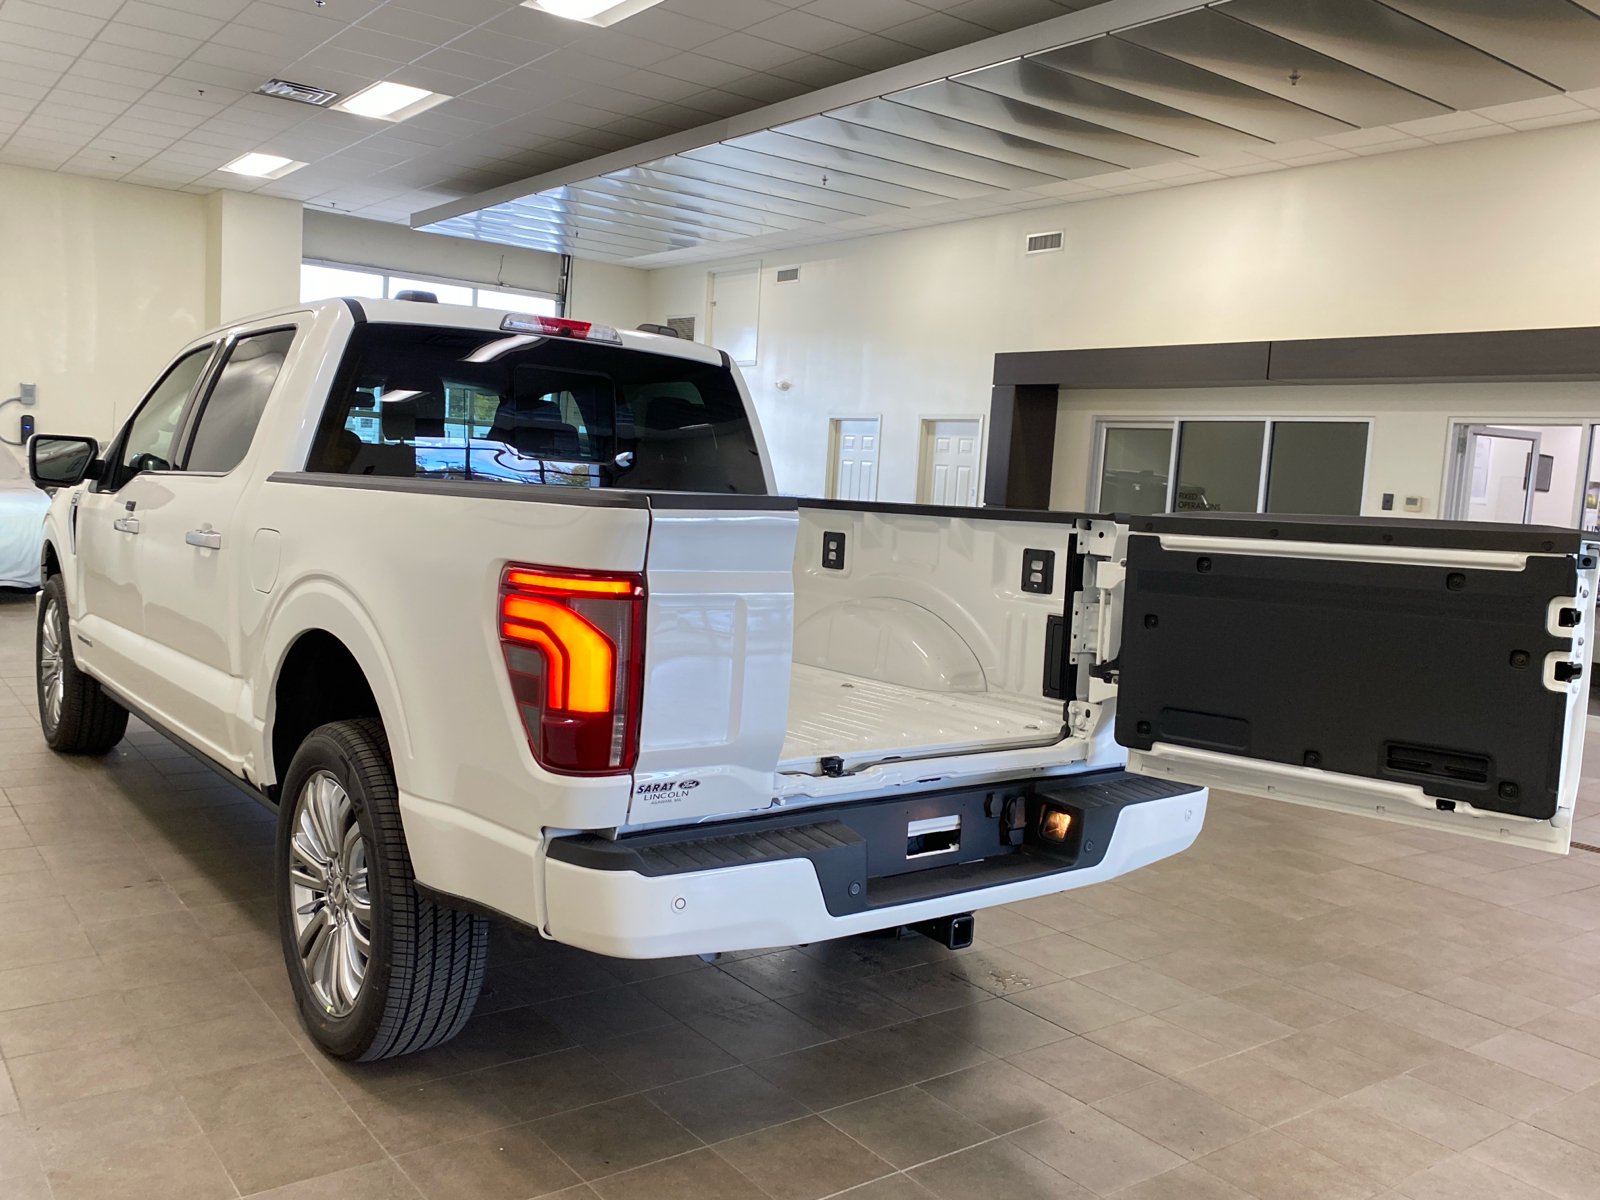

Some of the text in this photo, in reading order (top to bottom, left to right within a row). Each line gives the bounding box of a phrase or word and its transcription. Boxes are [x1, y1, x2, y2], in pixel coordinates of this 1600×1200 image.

[1179, 492, 1197, 500] FIXED
[636, 782, 676, 794] SARAT
[644, 791, 689, 801] LINCOLN
